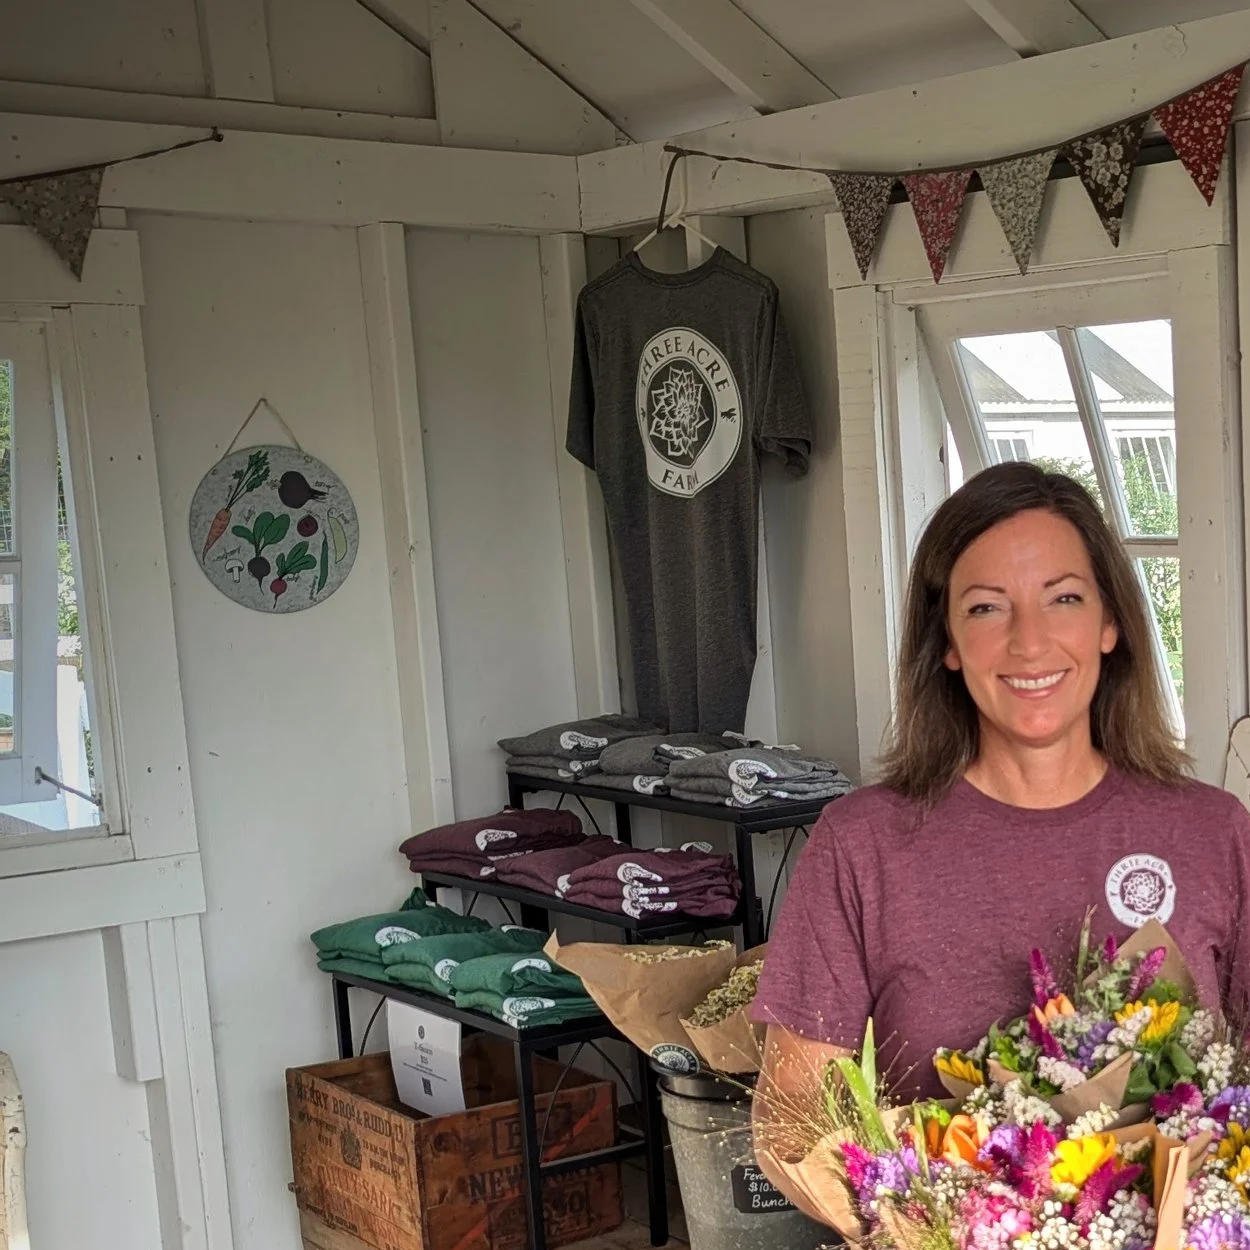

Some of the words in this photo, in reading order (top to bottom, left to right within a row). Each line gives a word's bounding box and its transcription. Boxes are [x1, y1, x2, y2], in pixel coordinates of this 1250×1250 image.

[640, 336, 682, 388] THREE
[687, 340, 730, 392] ACRE
[748, 1181, 778, 1193] $10.0
[752, 1194, 794, 1208] Bunch
